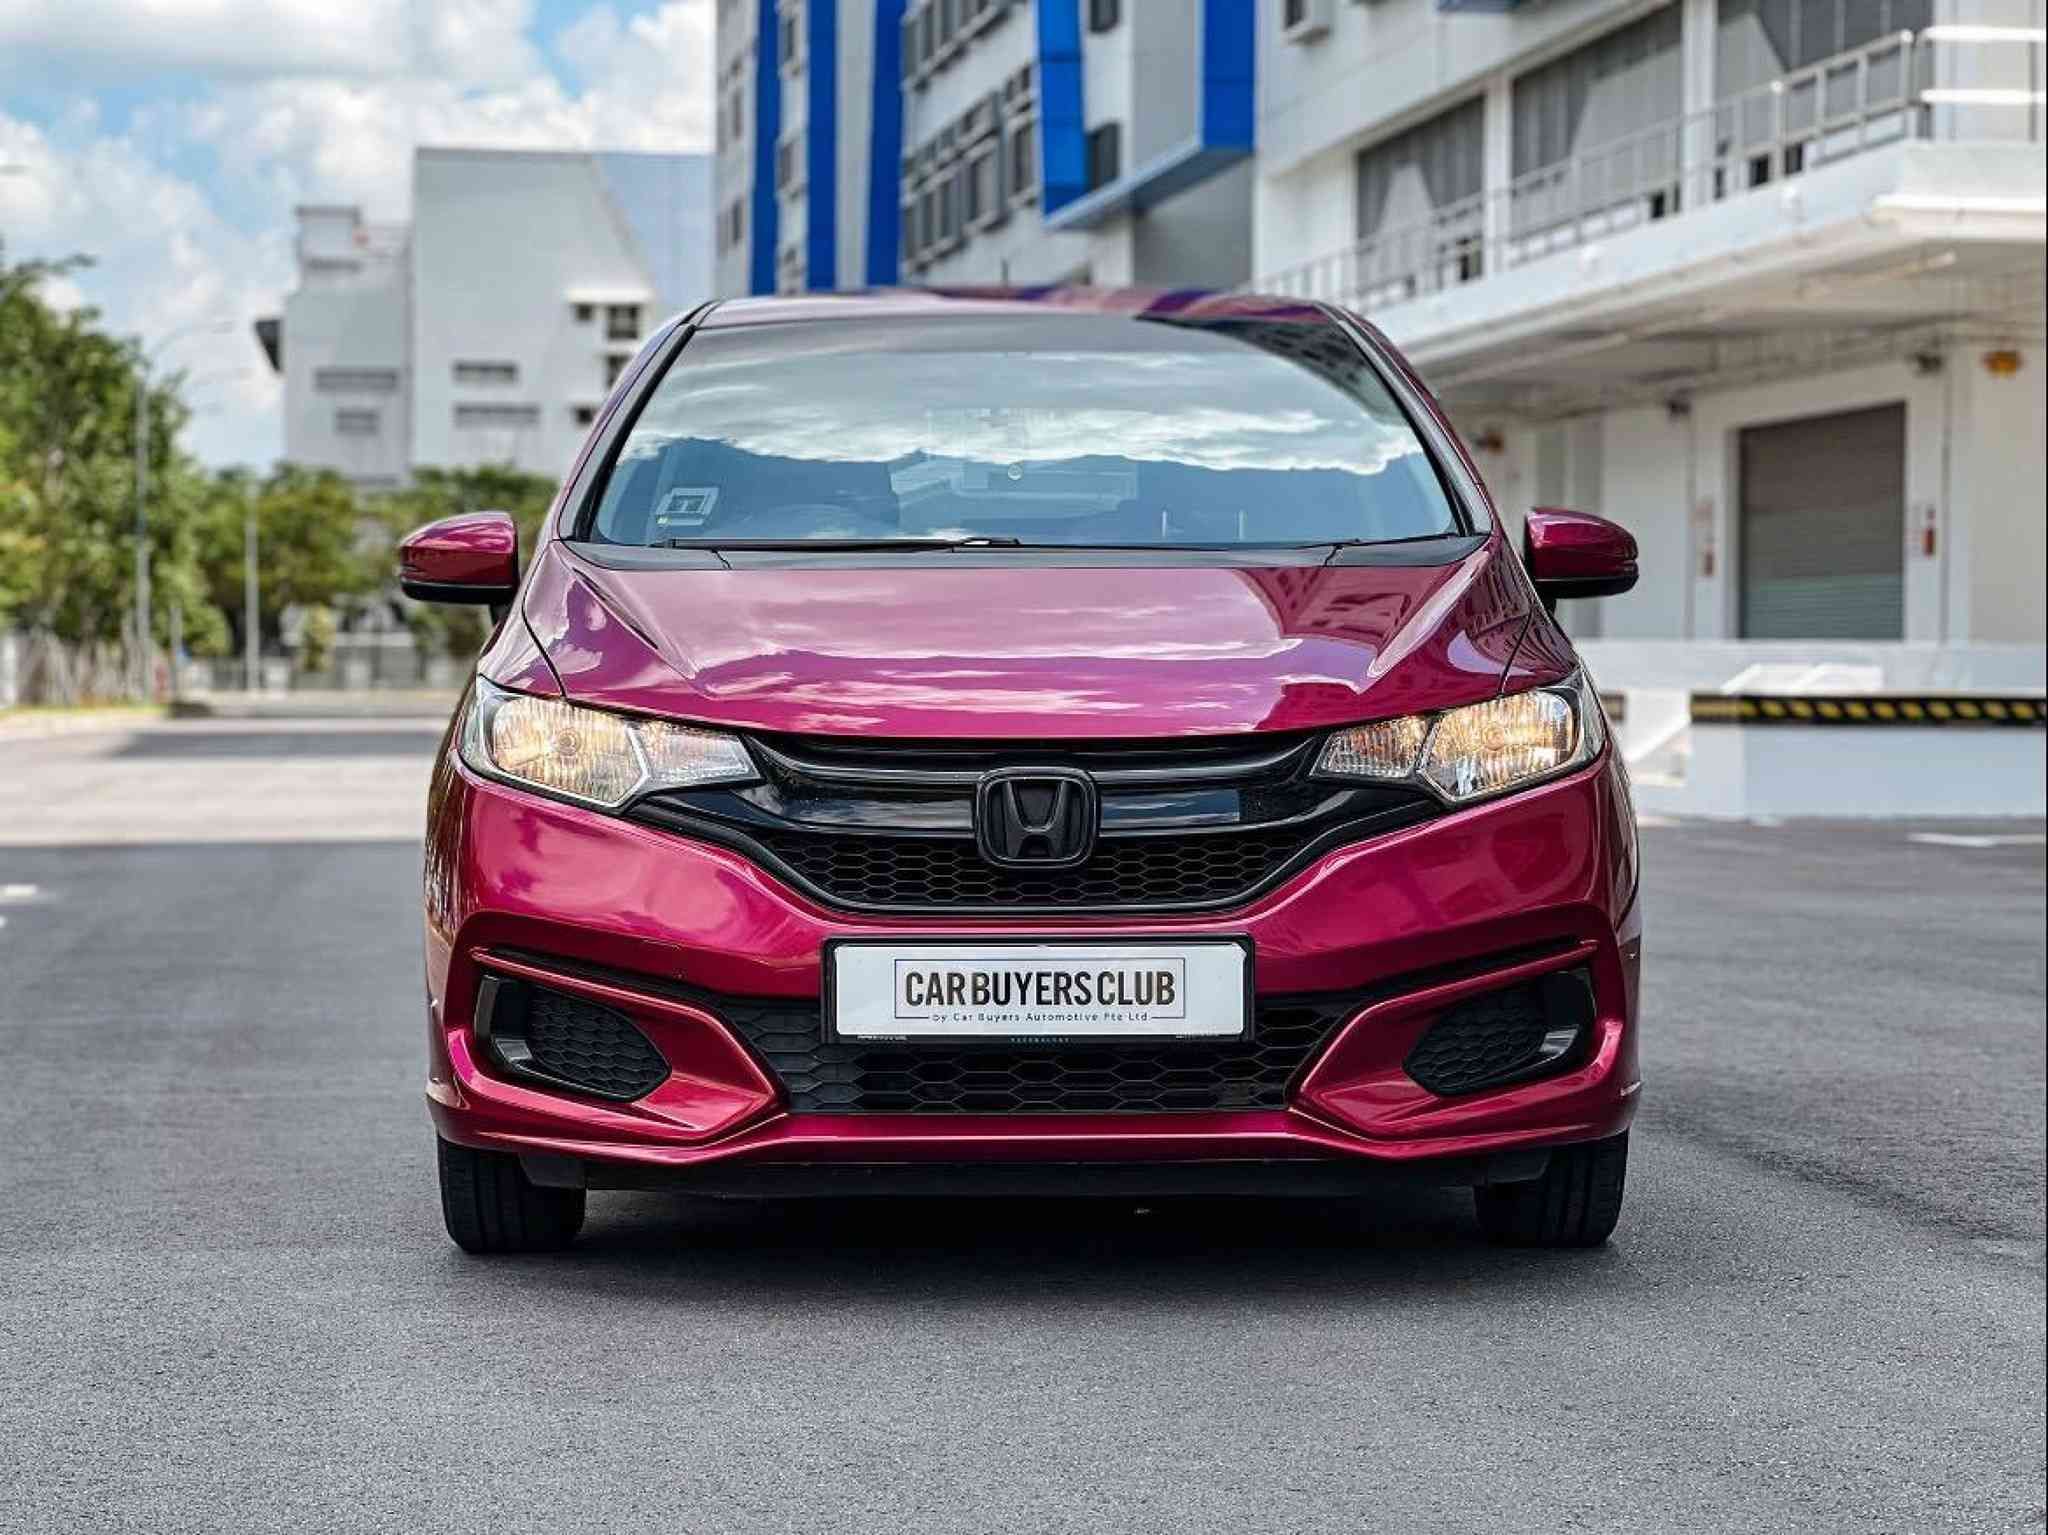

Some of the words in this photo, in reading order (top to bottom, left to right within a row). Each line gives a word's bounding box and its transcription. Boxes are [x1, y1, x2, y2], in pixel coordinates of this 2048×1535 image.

[905, 972, 966, 1006] CAR
[971, 972, 1092, 1006] BUYERS
[1097, 971, 1176, 1006] CLUB
[953, 1012, 973, 1022] Car
[978, 1012, 1020, 1024] Buyers
[1025, 1011, 1100, 1022] Automotive
[1128, 1012, 1148, 1022] Ltd
